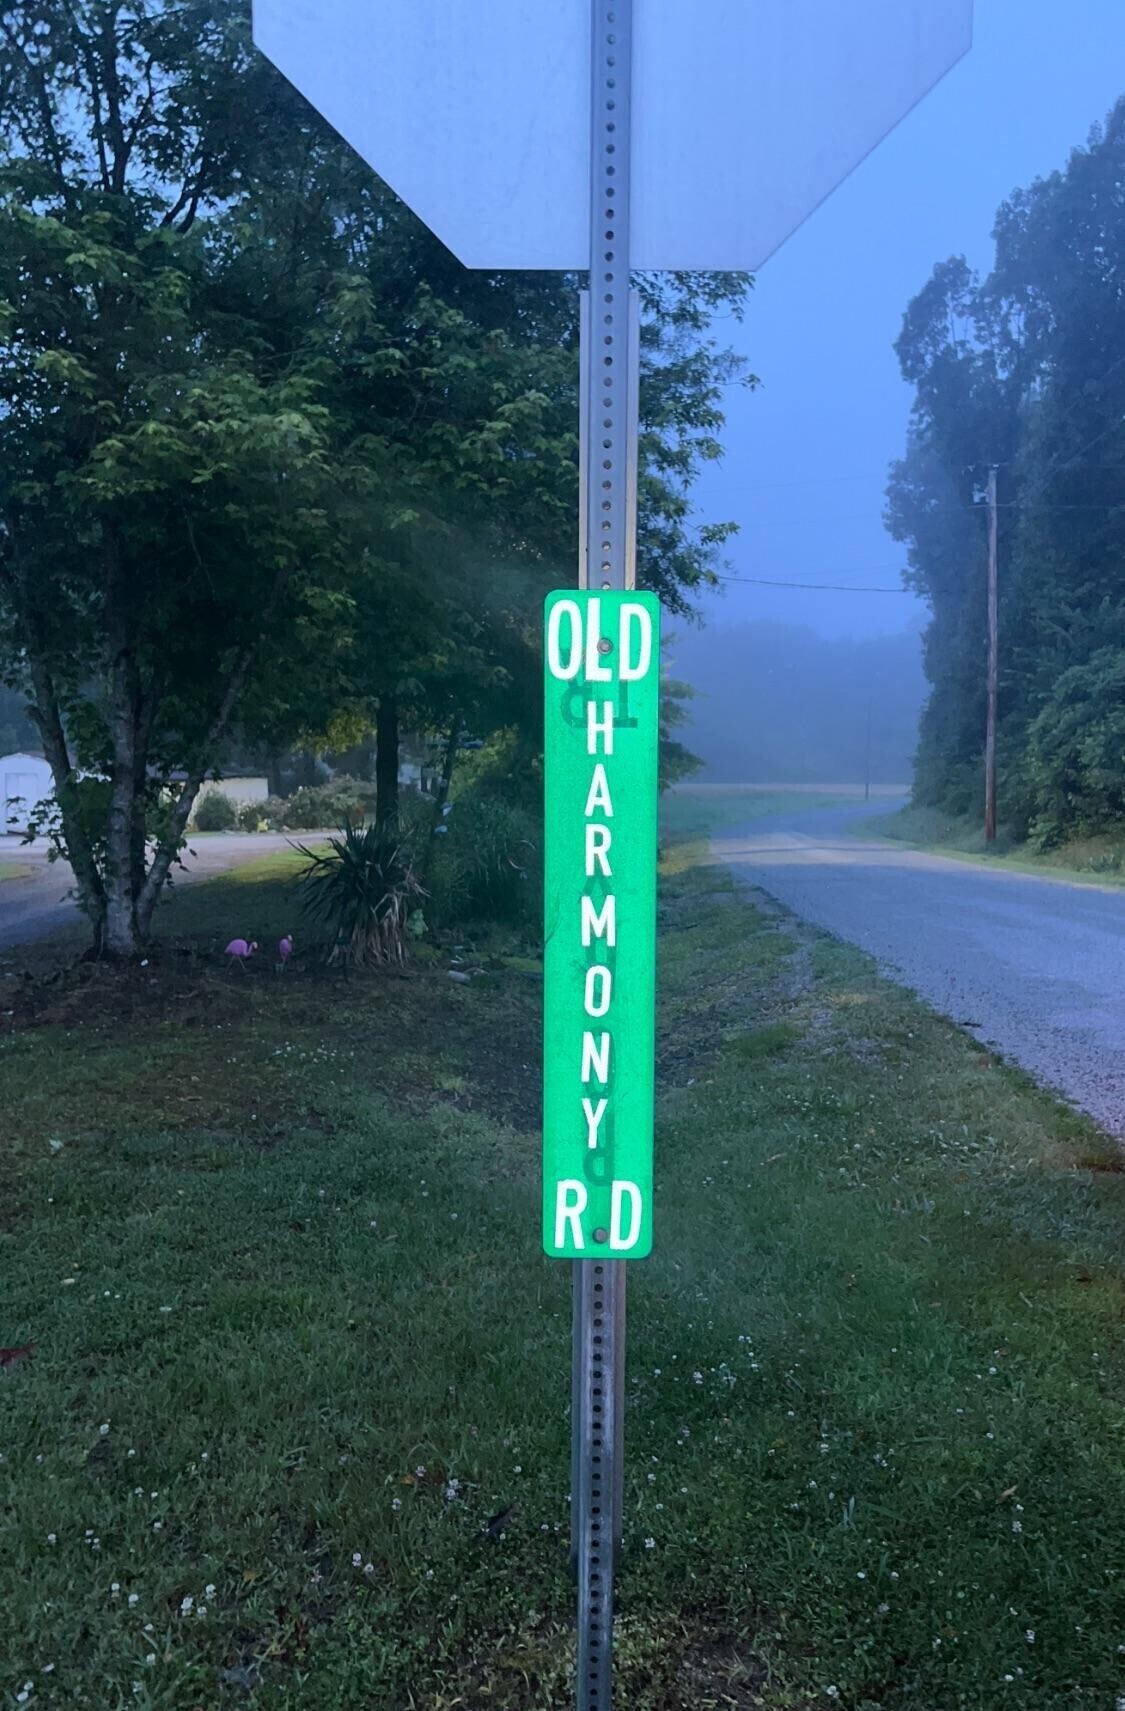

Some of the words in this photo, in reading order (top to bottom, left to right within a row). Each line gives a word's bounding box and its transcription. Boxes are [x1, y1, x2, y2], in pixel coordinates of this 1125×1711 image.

[548, 597, 652, 681] OLD
[581, 701, 616, 1149] HARMONY
[554, 1179, 642, 1250] RD
